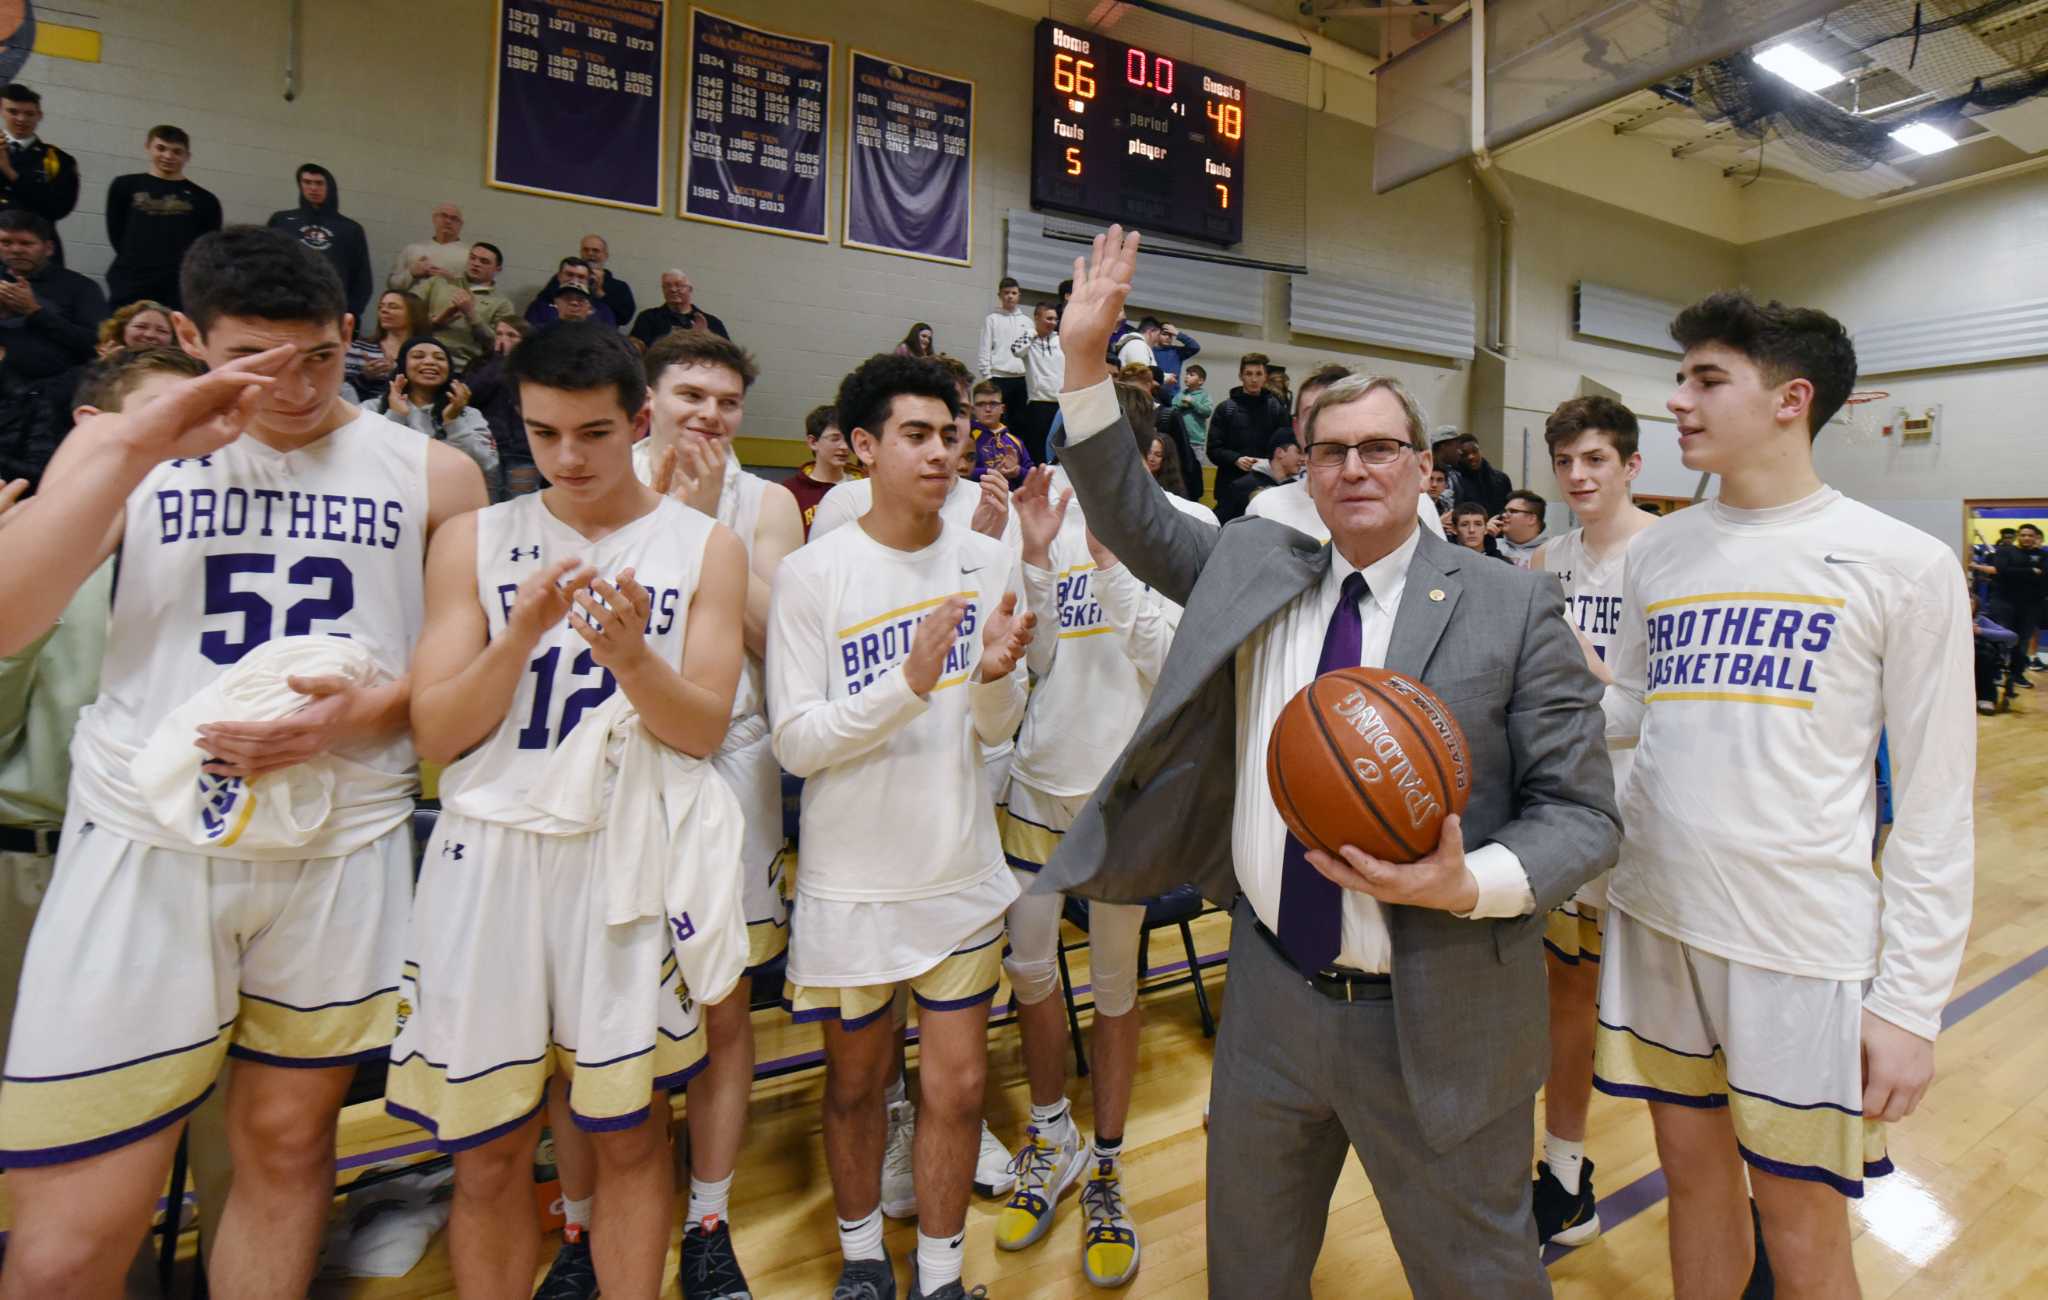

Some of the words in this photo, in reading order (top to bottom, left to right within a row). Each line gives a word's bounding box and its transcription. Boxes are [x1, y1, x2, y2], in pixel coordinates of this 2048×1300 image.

[507, 20, 540, 38] 1974
[508, 8, 540, 25] 1970
[548, 17, 576, 34] 1971
[588, 26, 618, 43] 1972
[626, 35, 654, 52] 1973
[1053, 28, 1090, 54] Home
[507, 44, 539, 61] 1980
[548, 54, 579, 70] 1983
[586, 61, 617, 78] 1984
[625, 71, 653, 86] 1985
[507, 56, 538, 73] 1987
[547, 66, 575, 82] 1991
[586, 75, 619, 91] 2004
[624, 82, 653, 97] 2013
[1054, 53, 1096, 99] 66
[1126, 48, 1174, 95] 0.0
[1203, 75, 1241, 101] Guests
[1129, 112, 1169, 133] period
[1207, 100, 1242, 140] 48
[1066, 147, 1082, 176] 5
[1129, 138, 1167, 160] player
[692, 185, 719, 200] 1985
[759, 199, 785, 214] 2013
[1215, 184, 1229, 209] 7
[157, 487, 403, 550] BROTHERS
[200, 552, 354, 665] 52
[1647, 607, 1836, 656] BROTHERS
[518, 646, 617, 749] 12
[1333, 688, 1441, 831] SPALDING
